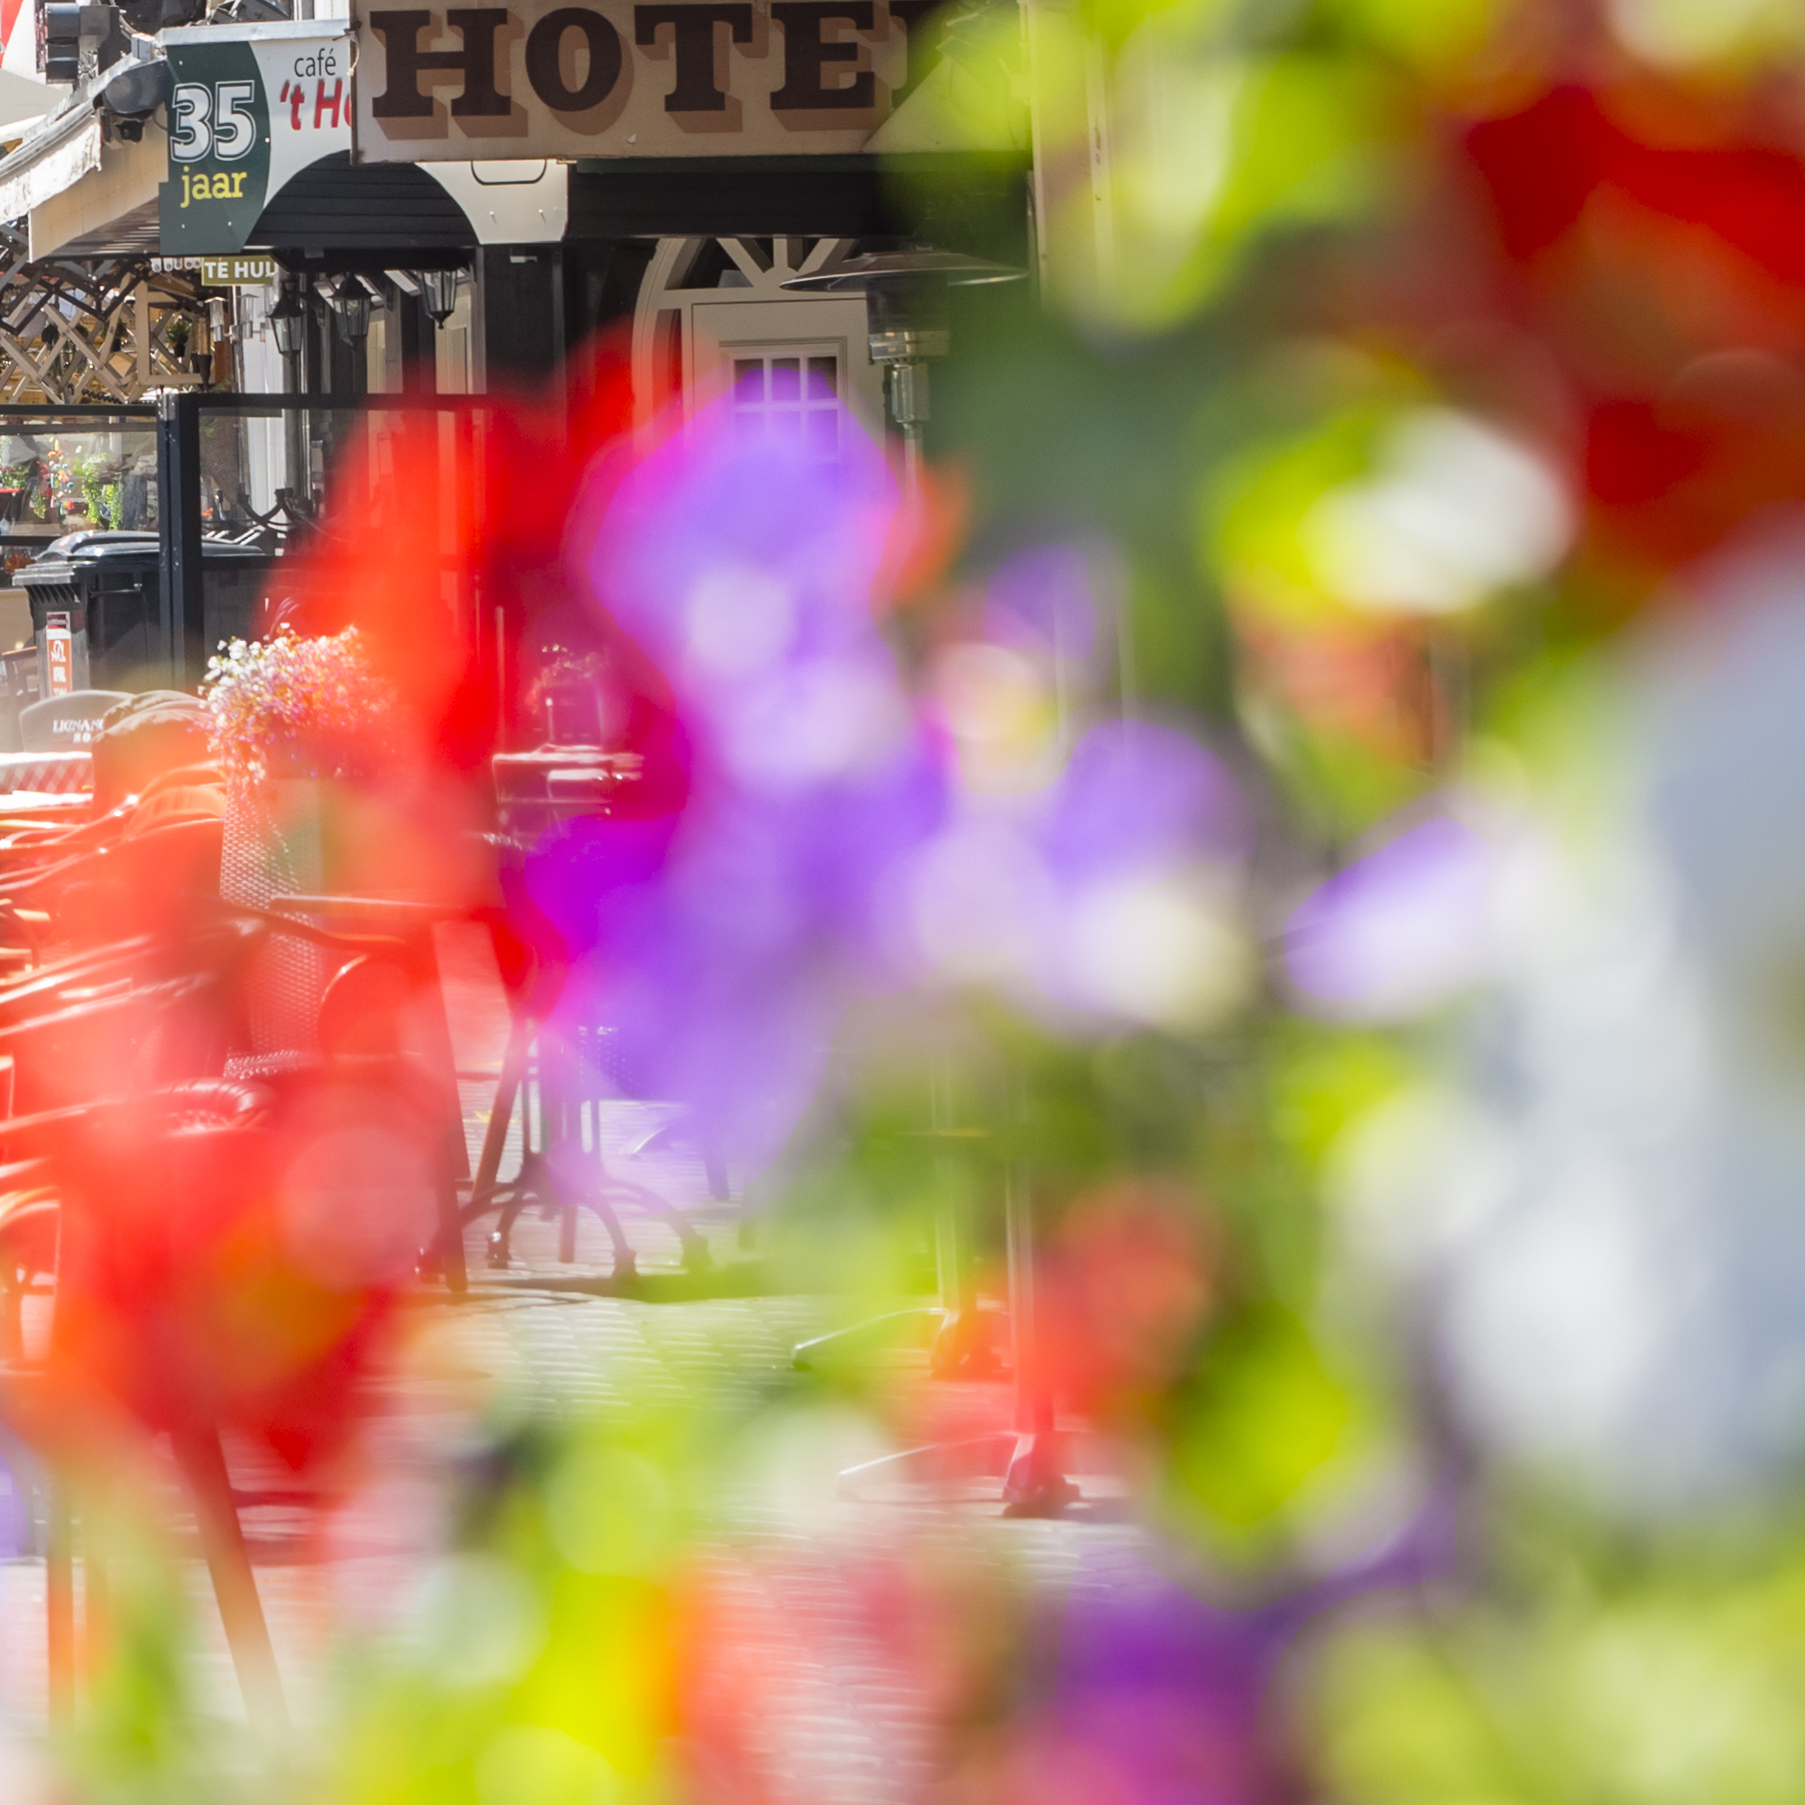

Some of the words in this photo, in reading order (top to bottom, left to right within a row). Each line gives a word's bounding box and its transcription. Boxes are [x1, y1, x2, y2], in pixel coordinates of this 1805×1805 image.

[294, 48, 336, 77] café
[170, 80, 257, 163] 35
[181, 165, 247, 208] jaar
[205, 261, 229, 278] TE
